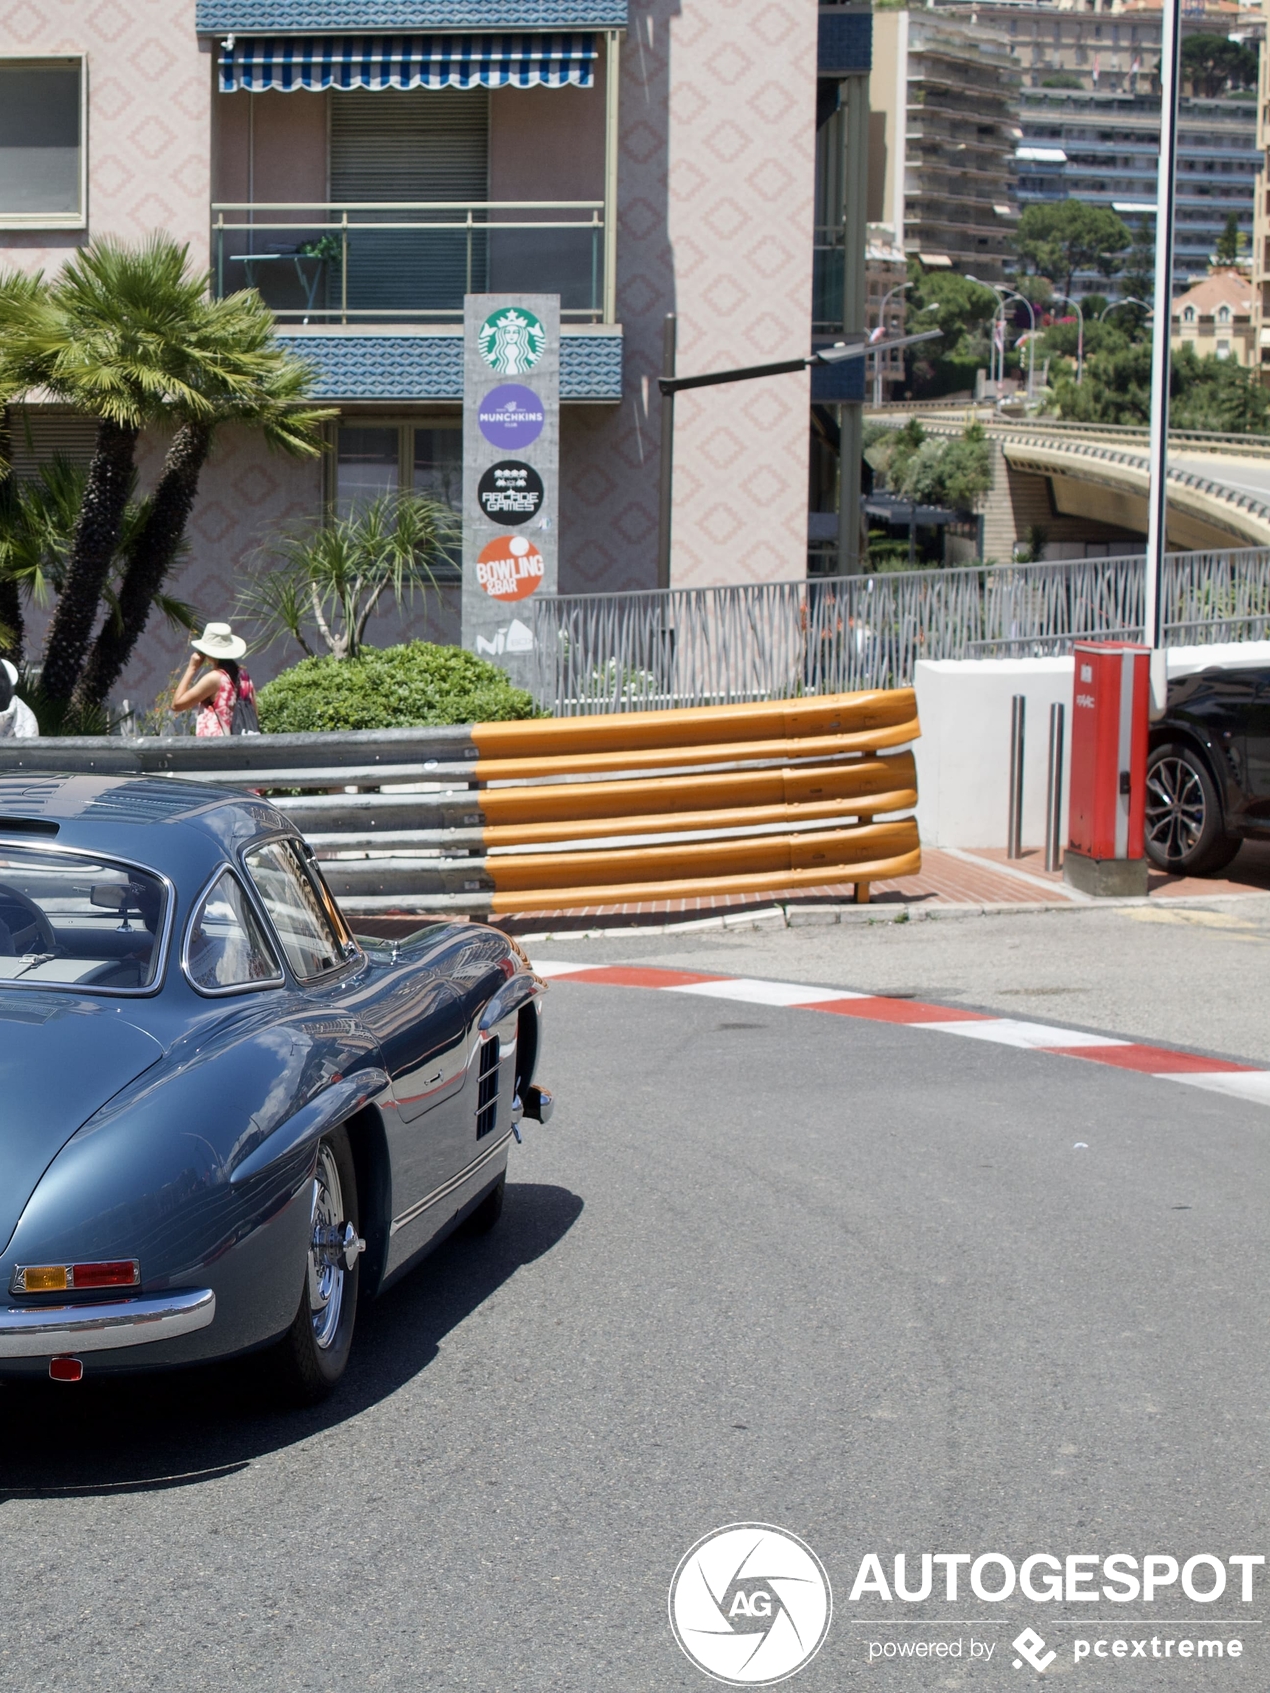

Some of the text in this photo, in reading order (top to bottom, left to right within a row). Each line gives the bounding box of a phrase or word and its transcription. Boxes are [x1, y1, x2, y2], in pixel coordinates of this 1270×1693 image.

[479, 413, 543, 421] MUNCHKINS
[482, 492, 539, 502] ARCADE
[487, 501, 534, 511] GAMES
[476, 555, 544, 584] BOWLING
[486, 578, 518, 596] &BAR
